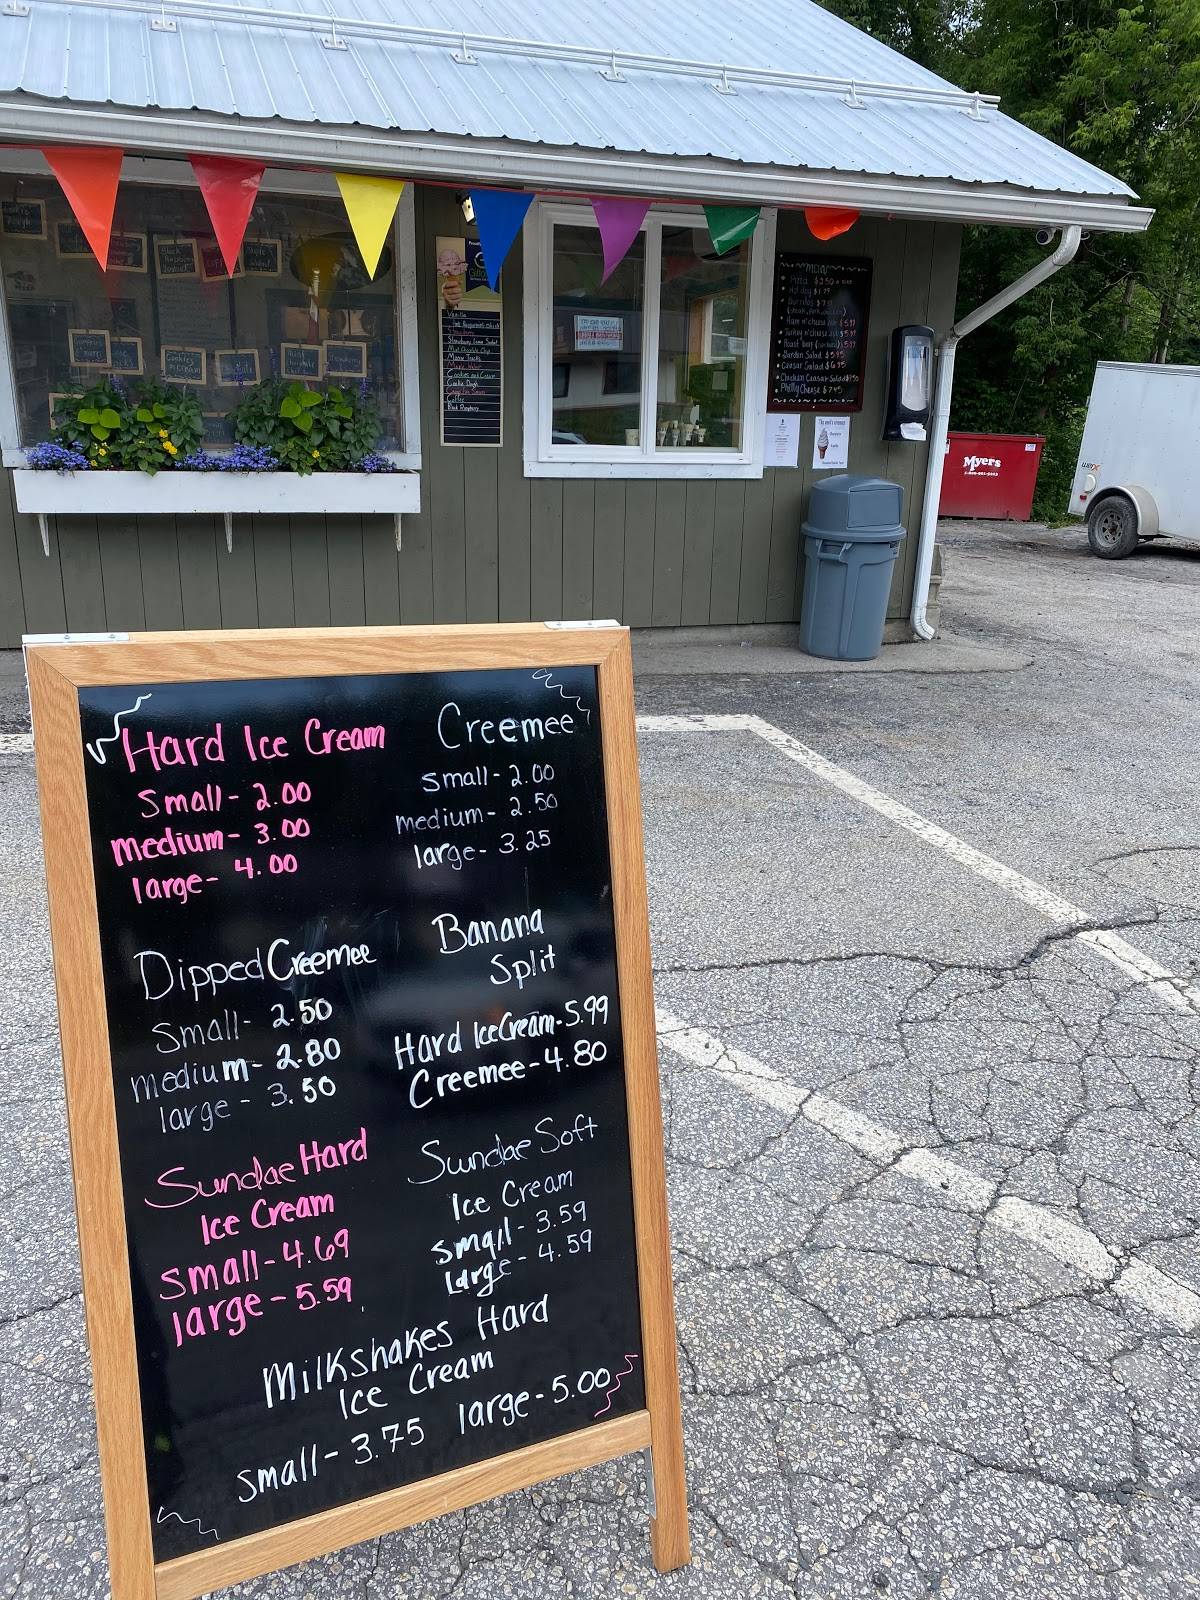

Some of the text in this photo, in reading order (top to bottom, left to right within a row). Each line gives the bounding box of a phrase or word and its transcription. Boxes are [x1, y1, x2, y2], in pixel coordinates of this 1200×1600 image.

[963, 456, 1002, 472] Myers
[122, 717, 386, 773] Hard Ice Cream
[438, 702, 574, 749] Creemee
[508, 763, 555, 787] 2.00
[252, 781, 312, 812] 2.00
[508, 792, 559, 818] 2.50
[253, 817, 312, 846] 3.00
[498, 829, 552, 855] 3.25
[234, 853, 299, 880] 4.00
[431, 907, 546, 955] Banana
[133, 937, 378, 1003] Dipped Creemee
[489, 943, 557, 991] Split
[270, 997, 334, 1030] 2.50
[275, 1037, 343, 1071] 2.80
[393, 1020, 464, 1072] Hard
[544, 1038, 608, 1074] 4.80
[267, 1074, 338, 1108] 3.50
[143, 1126, 369, 1209] Sundae Hard
[406, 1112, 599, 1185] Sundae Soft
[450, 1169, 574, 1223] Ice Cream
[199, 1192, 336, 1246] Ice Cream
[535, 1199, 588, 1235] 3.59
[281, 1227, 351, 1270] 4.69
[537, 1228, 594, 1263] 4.59
[294, 1275, 354, 1312] 5.59
[476, 1294, 550, 1341] Hard
[337, 1350, 495, 1421] Ice Cream
[349, 1415, 427, 1467] 3.75
[550, 1366, 613, 1405] 5.00
